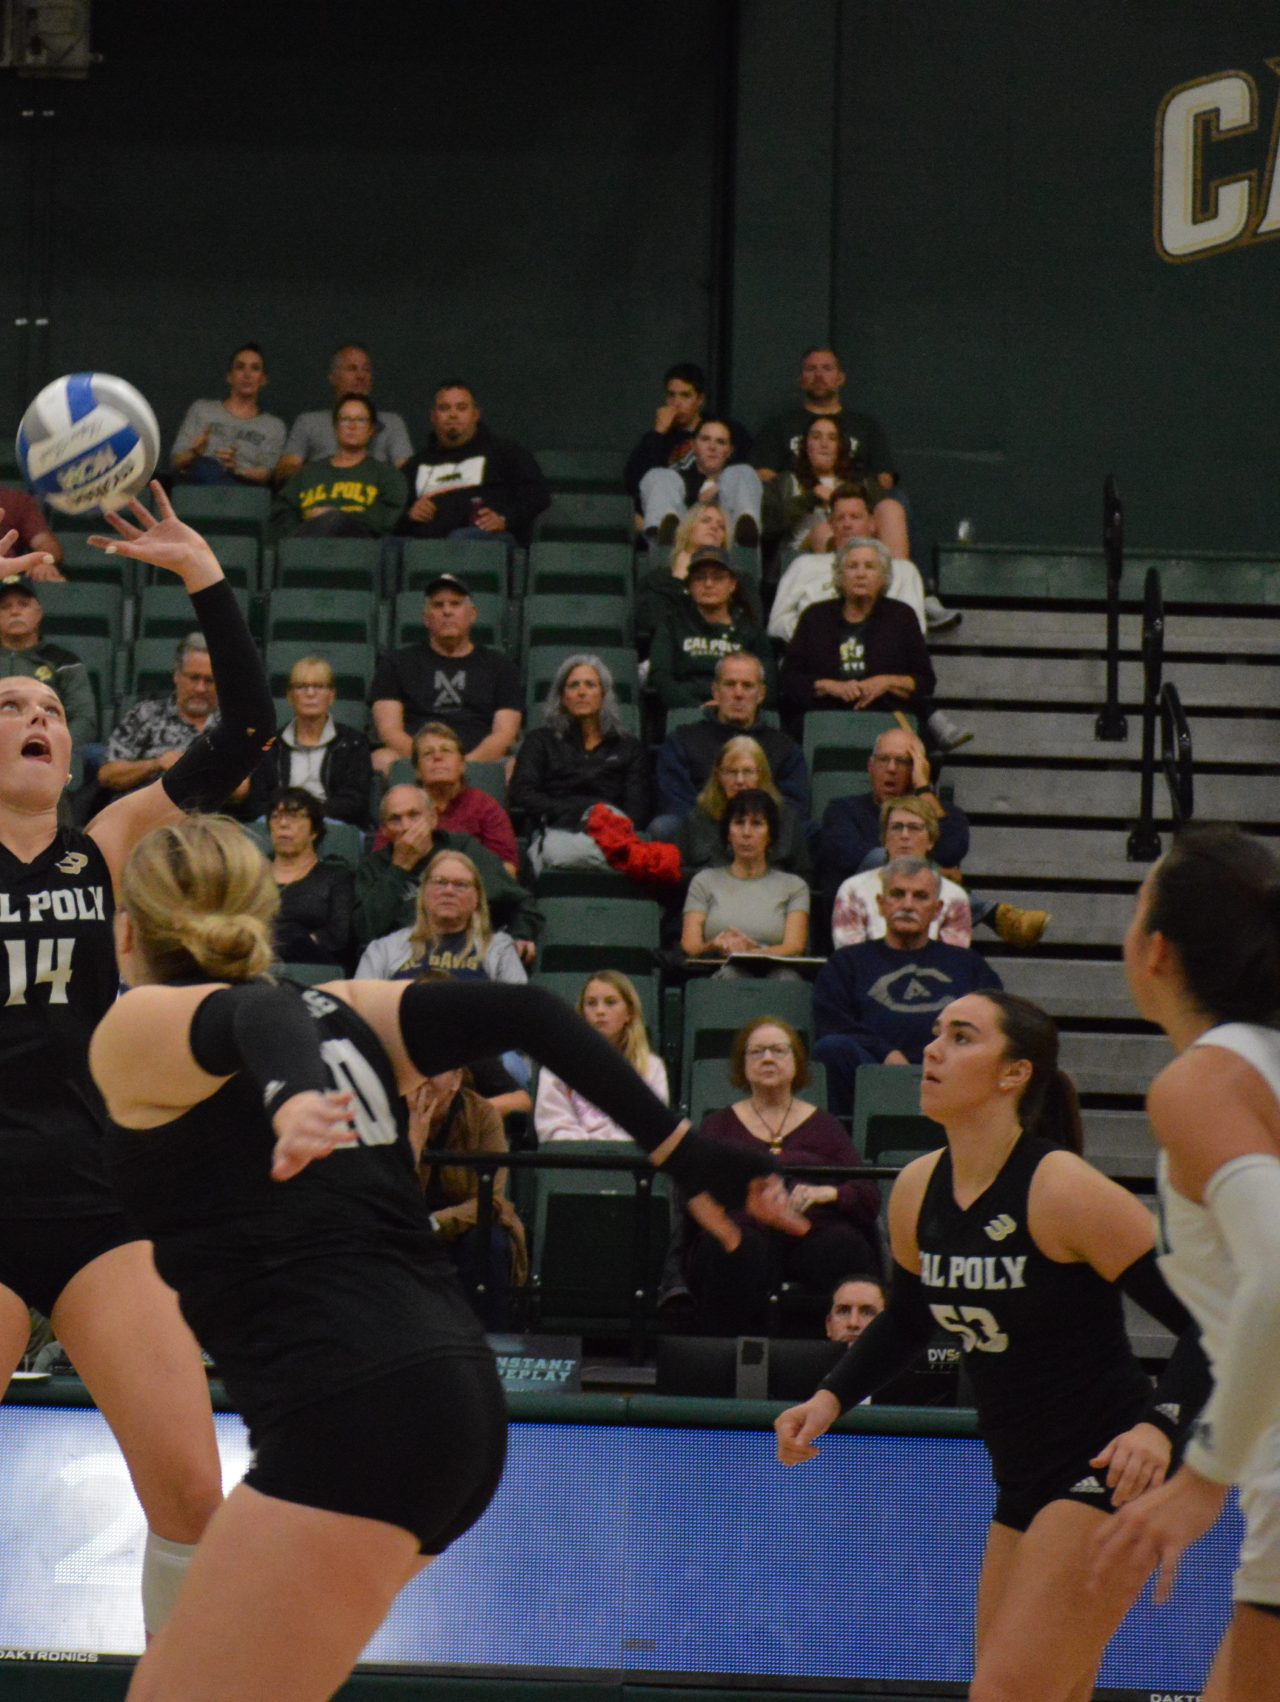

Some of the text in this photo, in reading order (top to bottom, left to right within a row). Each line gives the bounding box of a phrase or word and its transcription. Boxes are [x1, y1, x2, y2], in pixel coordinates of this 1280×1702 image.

[1153, 56, 1280, 265] C
[330, 481, 378, 506] POLY
[26, 886, 106, 923] POLY
[3, 937, 76, 1007] 14
[921, 1253, 1027, 1290] AL POLY
[928, 1304, 1008, 1353] 53
[495, 1356, 576, 1370] NSTANT
